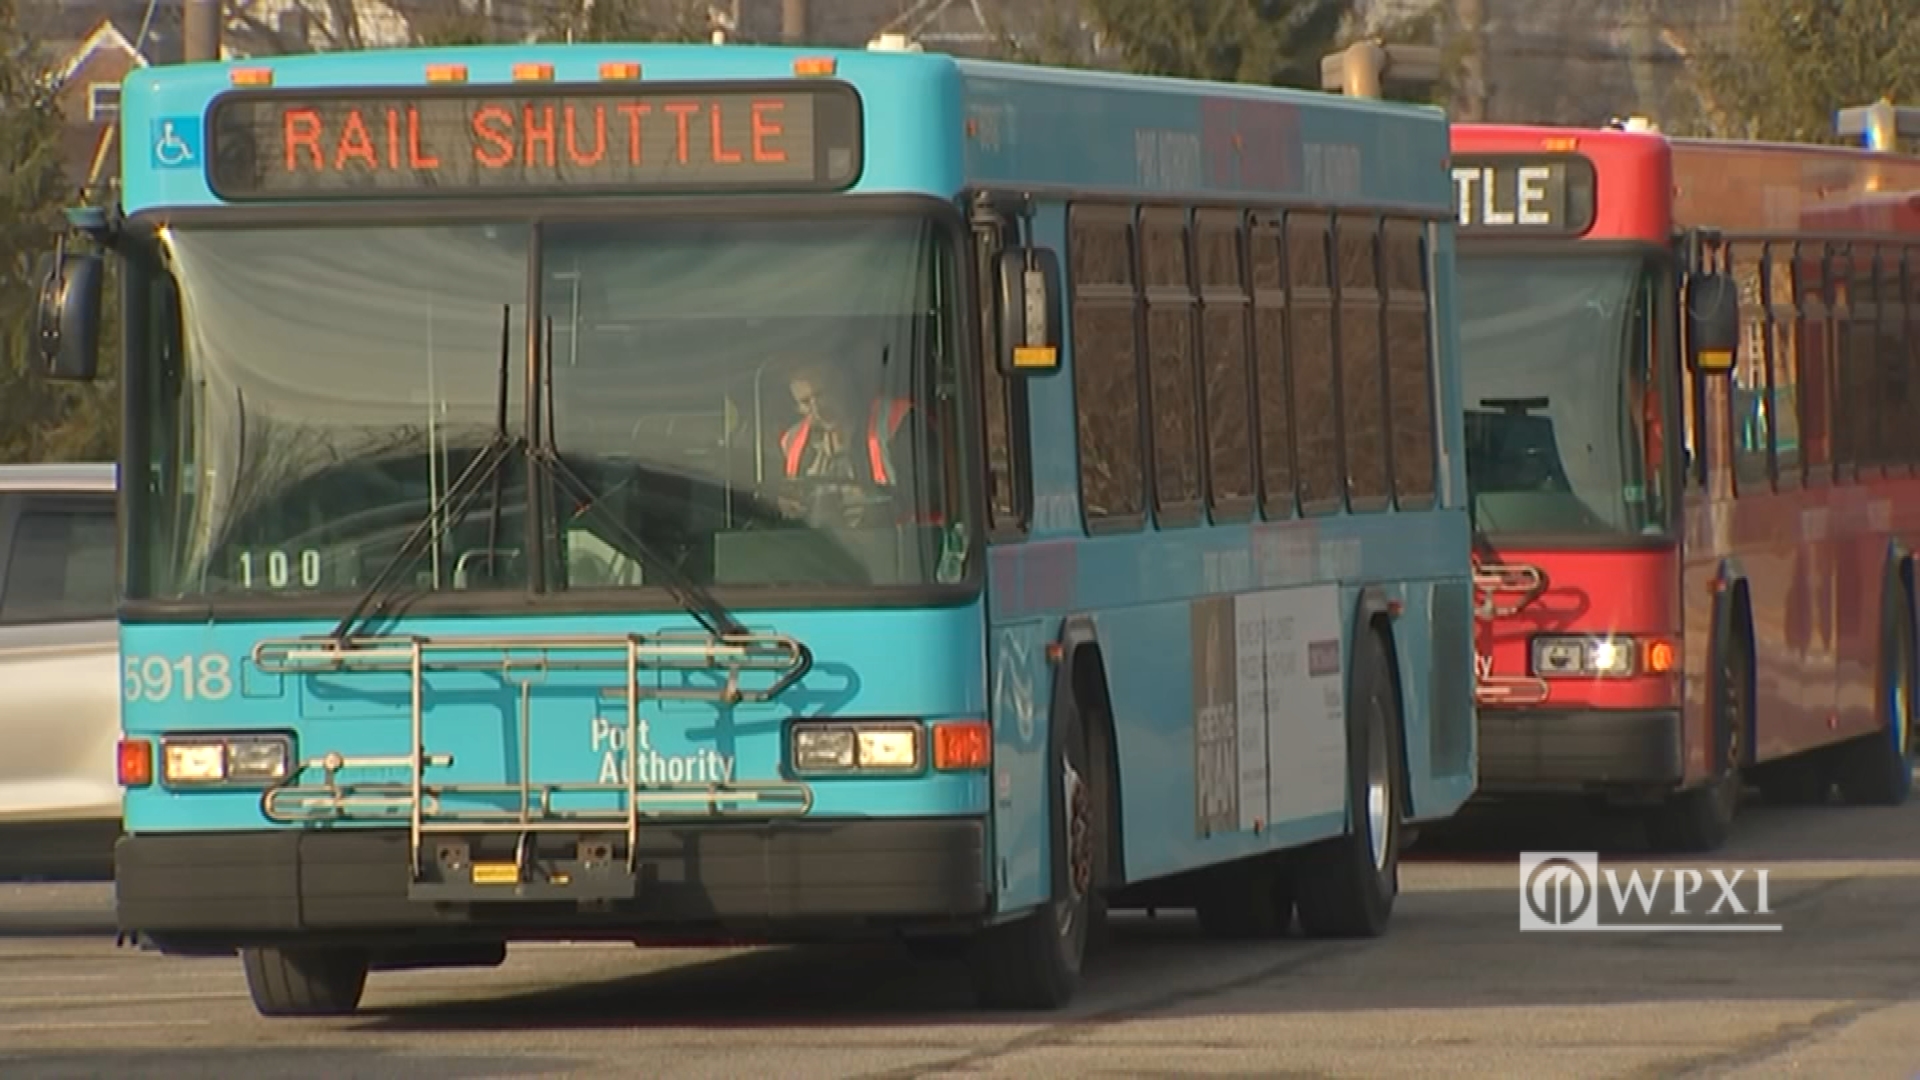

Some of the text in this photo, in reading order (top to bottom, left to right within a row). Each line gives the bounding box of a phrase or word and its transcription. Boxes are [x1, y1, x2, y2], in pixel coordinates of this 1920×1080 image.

[282, 101, 789, 171] RAIL SHUTTLE
[1451, 167, 1549, 225] TLE
[240, 550, 320, 588] 100
[124, 653, 232, 701] 5918
[591, 718, 649, 752] Pot
